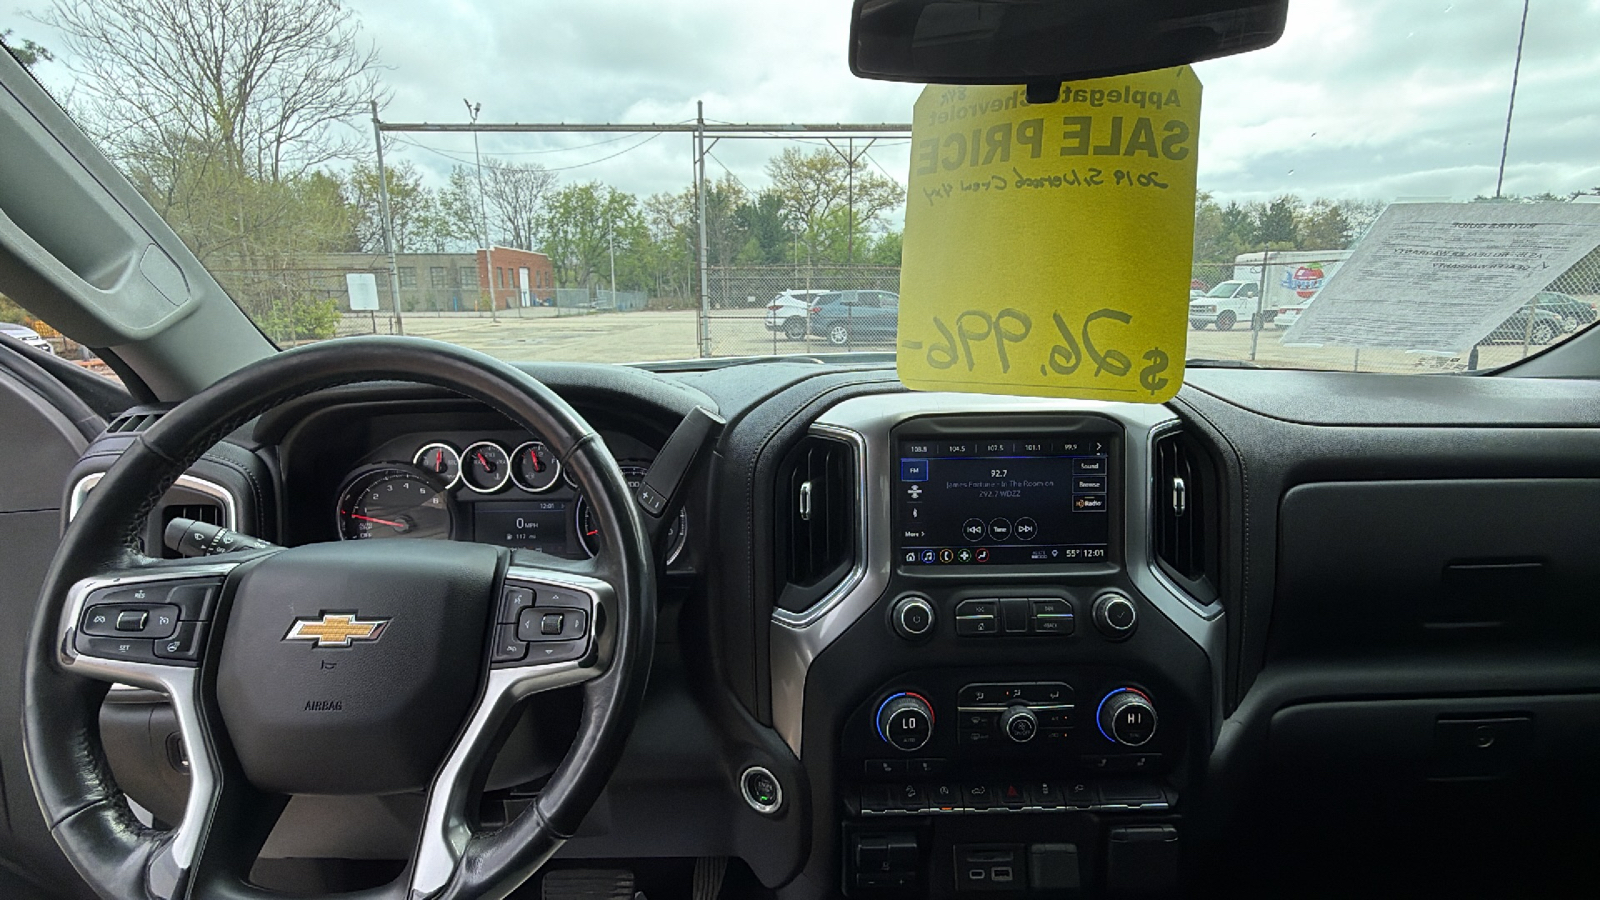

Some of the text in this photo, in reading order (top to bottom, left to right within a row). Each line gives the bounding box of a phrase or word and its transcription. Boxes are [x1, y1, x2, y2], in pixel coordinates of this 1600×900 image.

[990, 469, 1008, 477] 92.7
[946, 481, 967, 489] James
[516, 517, 524, 529] 0
[1083, 549, 1104, 557] 12:01
[304, 700, 343, 711] AIRBAG
[902, 717, 916, 729] LO
[1127, 713, 1141, 724] HI
